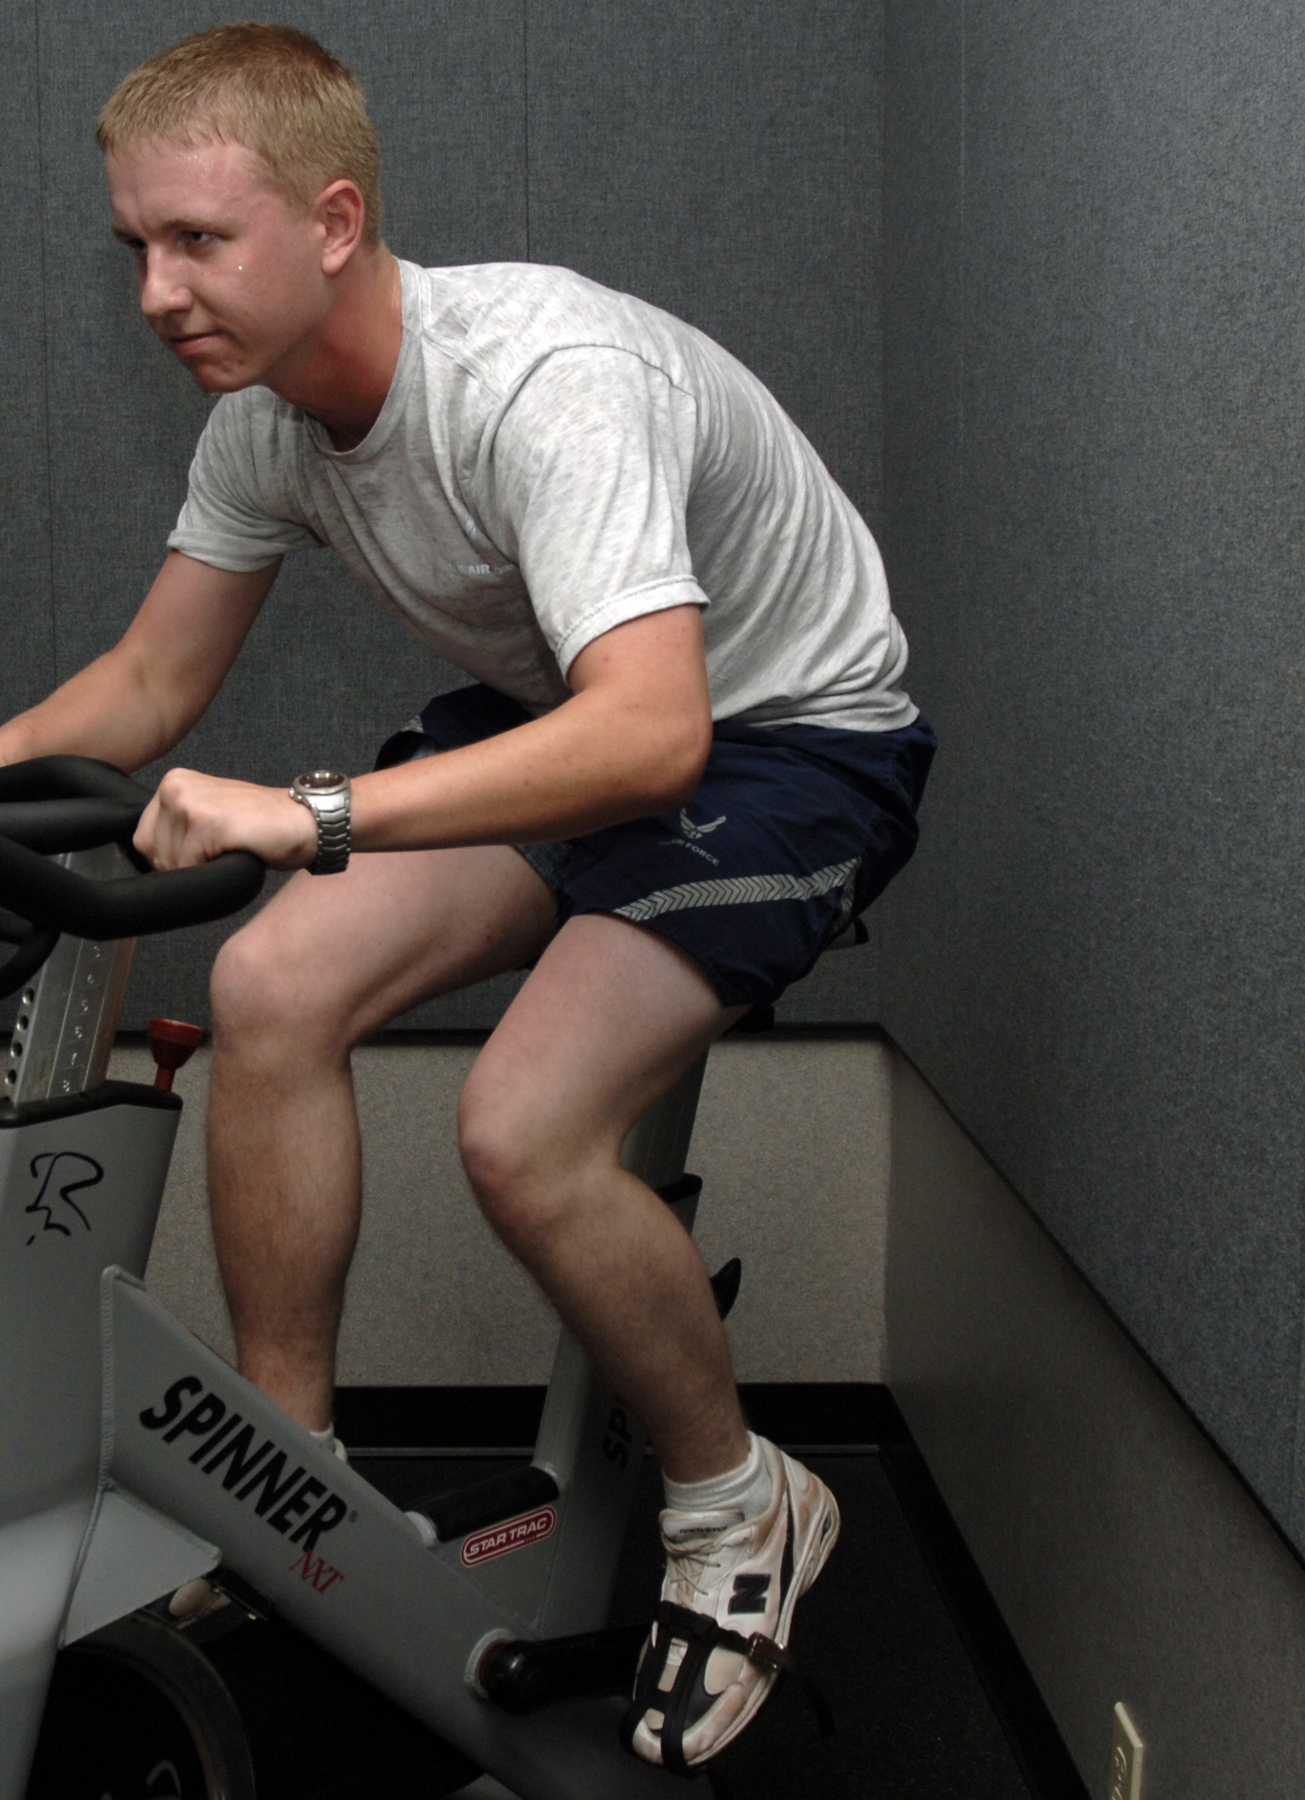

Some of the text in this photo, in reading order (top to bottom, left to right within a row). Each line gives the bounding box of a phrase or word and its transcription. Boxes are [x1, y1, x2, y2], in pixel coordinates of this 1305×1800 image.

[468, 564, 491, 575] AIR
[685, 843, 720, 866] FORCE
[139, 1376, 349, 1552] SPINNER
[469, 1517, 548, 1555] STAR TRAC
[288, 1550, 344, 1594] NXT
